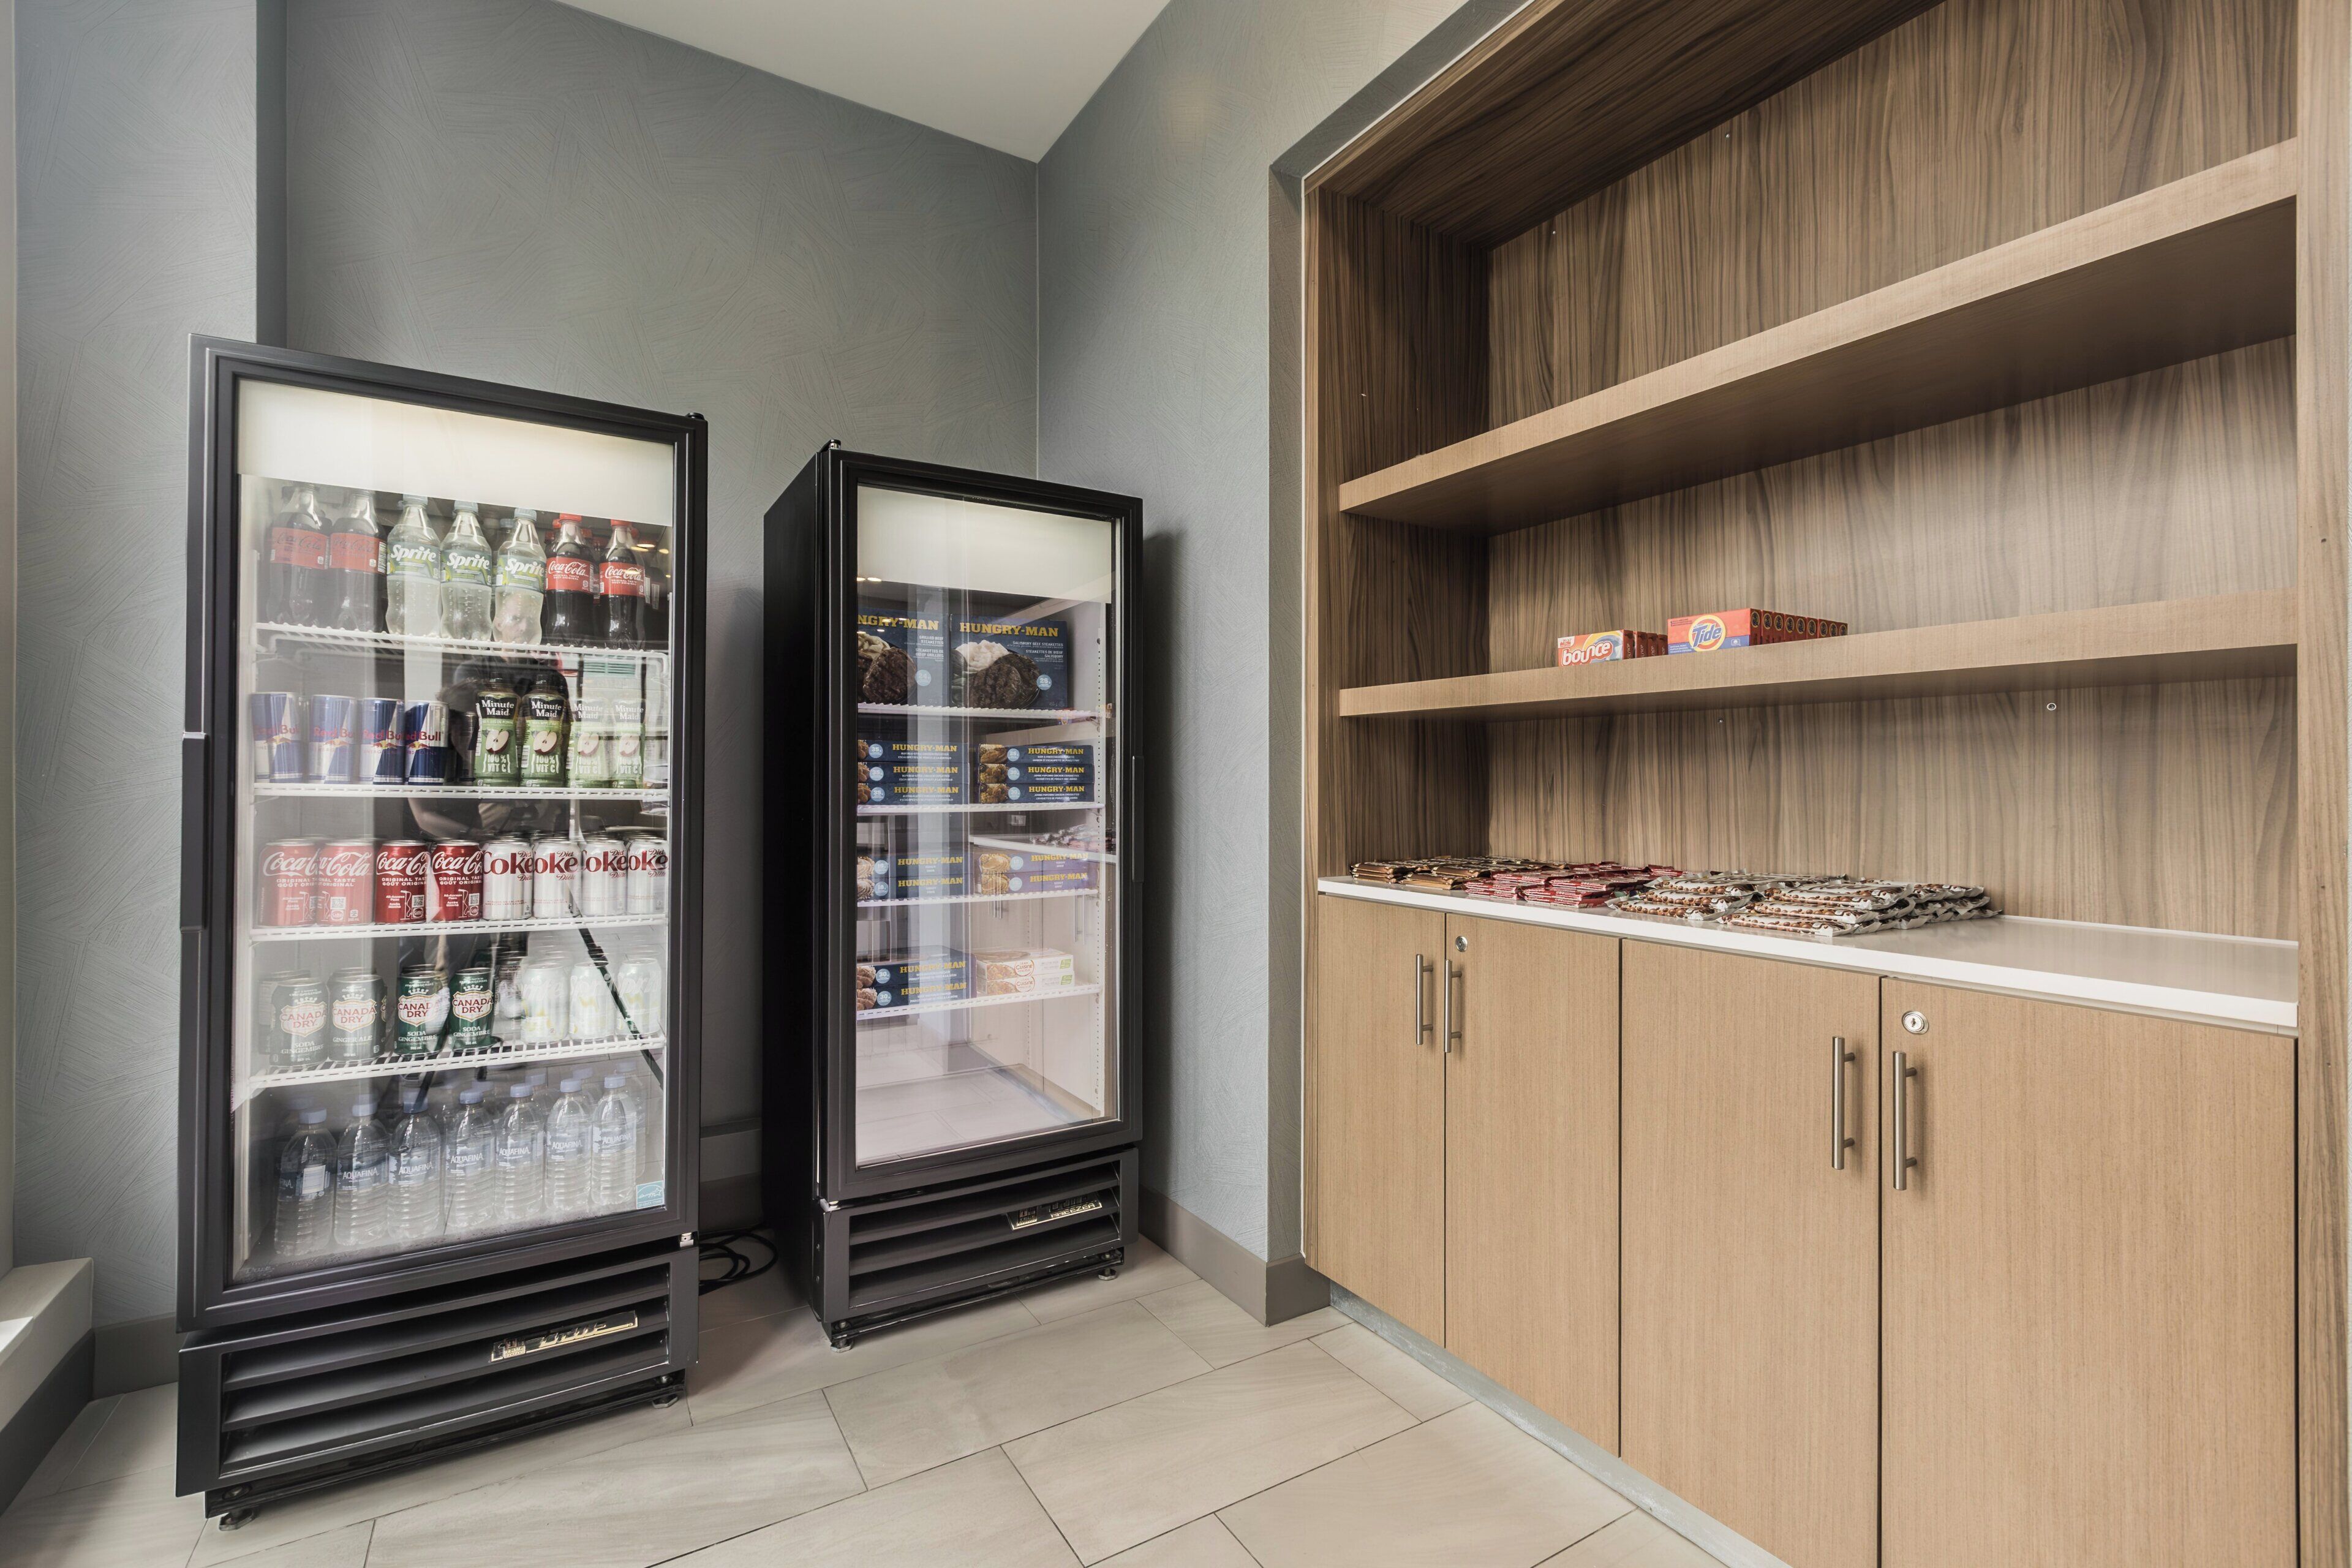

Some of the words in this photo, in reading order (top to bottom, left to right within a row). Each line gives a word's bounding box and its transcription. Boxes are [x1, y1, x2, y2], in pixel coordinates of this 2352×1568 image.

[391, 544, 436, 562] Sprite
[447, 552, 491, 570] Sprite
[505, 558, 545, 576] Sprite
[548, 560, 587, 576] Coca-Cola
[858, 614, 939, 630] NGRY-MAN
[959, 622, 1059, 637] HUNGRY-MAN
[1692, 623, 1722, 648] Tide
[1562, 642, 1611, 666] bounce
[481, 699, 514, 709] Minute
[531, 701, 562, 710] Minute
[615, 704, 644, 713] Minute
[486, 707, 509, 716] Maid
[536, 709, 557, 718] Maid
[578, 710, 598, 719] Maid
[419, 731, 441, 741] Bull
[892, 744, 957, 752] HUNGRY-MAN
[483, 851, 533, 875] Coke
[534, 852, 578, 874] oke
[628, 850, 668, 871] oke
[898, 856, 963, 865] HUNGRY-MAN
[1031, 853, 1088, 862] HUNGRY-MAN
[898, 877, 963, 887] HUNGRY-MAN
[1030, 872, 1088, 883] HUNGRY-MAN
[453, 998, 494, 1006] CANADA
[281, 1010, 326, 1022] CANADA
[333, 1007, 376, 1016] CANADA
[551, 1139, 582, 1150] AQUAFINA
[499, 1146, 530, 1157] AQUAFINA
[450, 1153, 484, 1164] AQUAFINA
[342, 1167, 378, 1180] AQUAFINA
[399, 1161, 434, 1175] AQUAFINA
[1050, 1202, 1095, 1218] FREEZER
